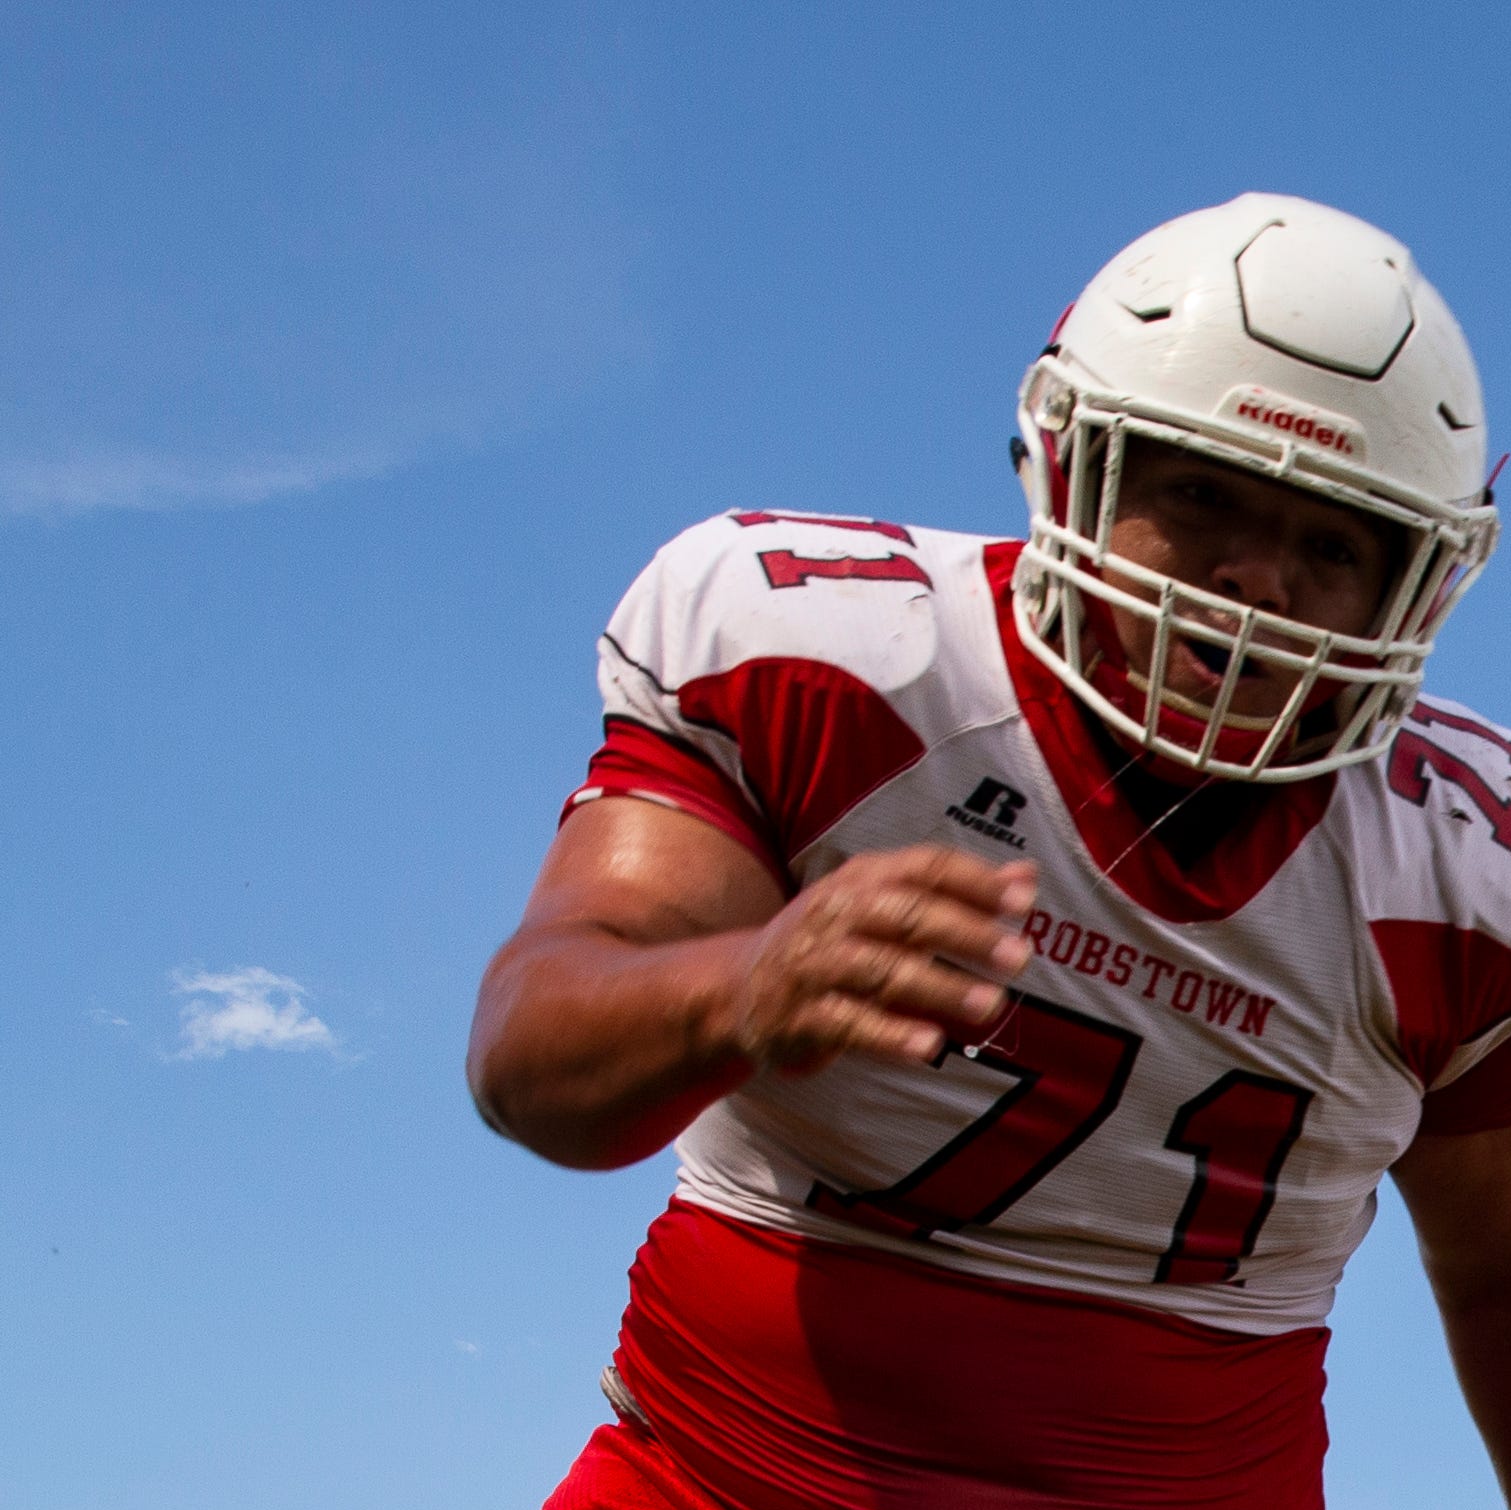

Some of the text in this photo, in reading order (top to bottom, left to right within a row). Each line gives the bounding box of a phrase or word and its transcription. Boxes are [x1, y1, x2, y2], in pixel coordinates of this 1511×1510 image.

[1236, 402, 1353, 455] Riddel
[1021, 908, 1277, 1037] ROBSTOWN
[806, 989, 1315, 1289] 71
